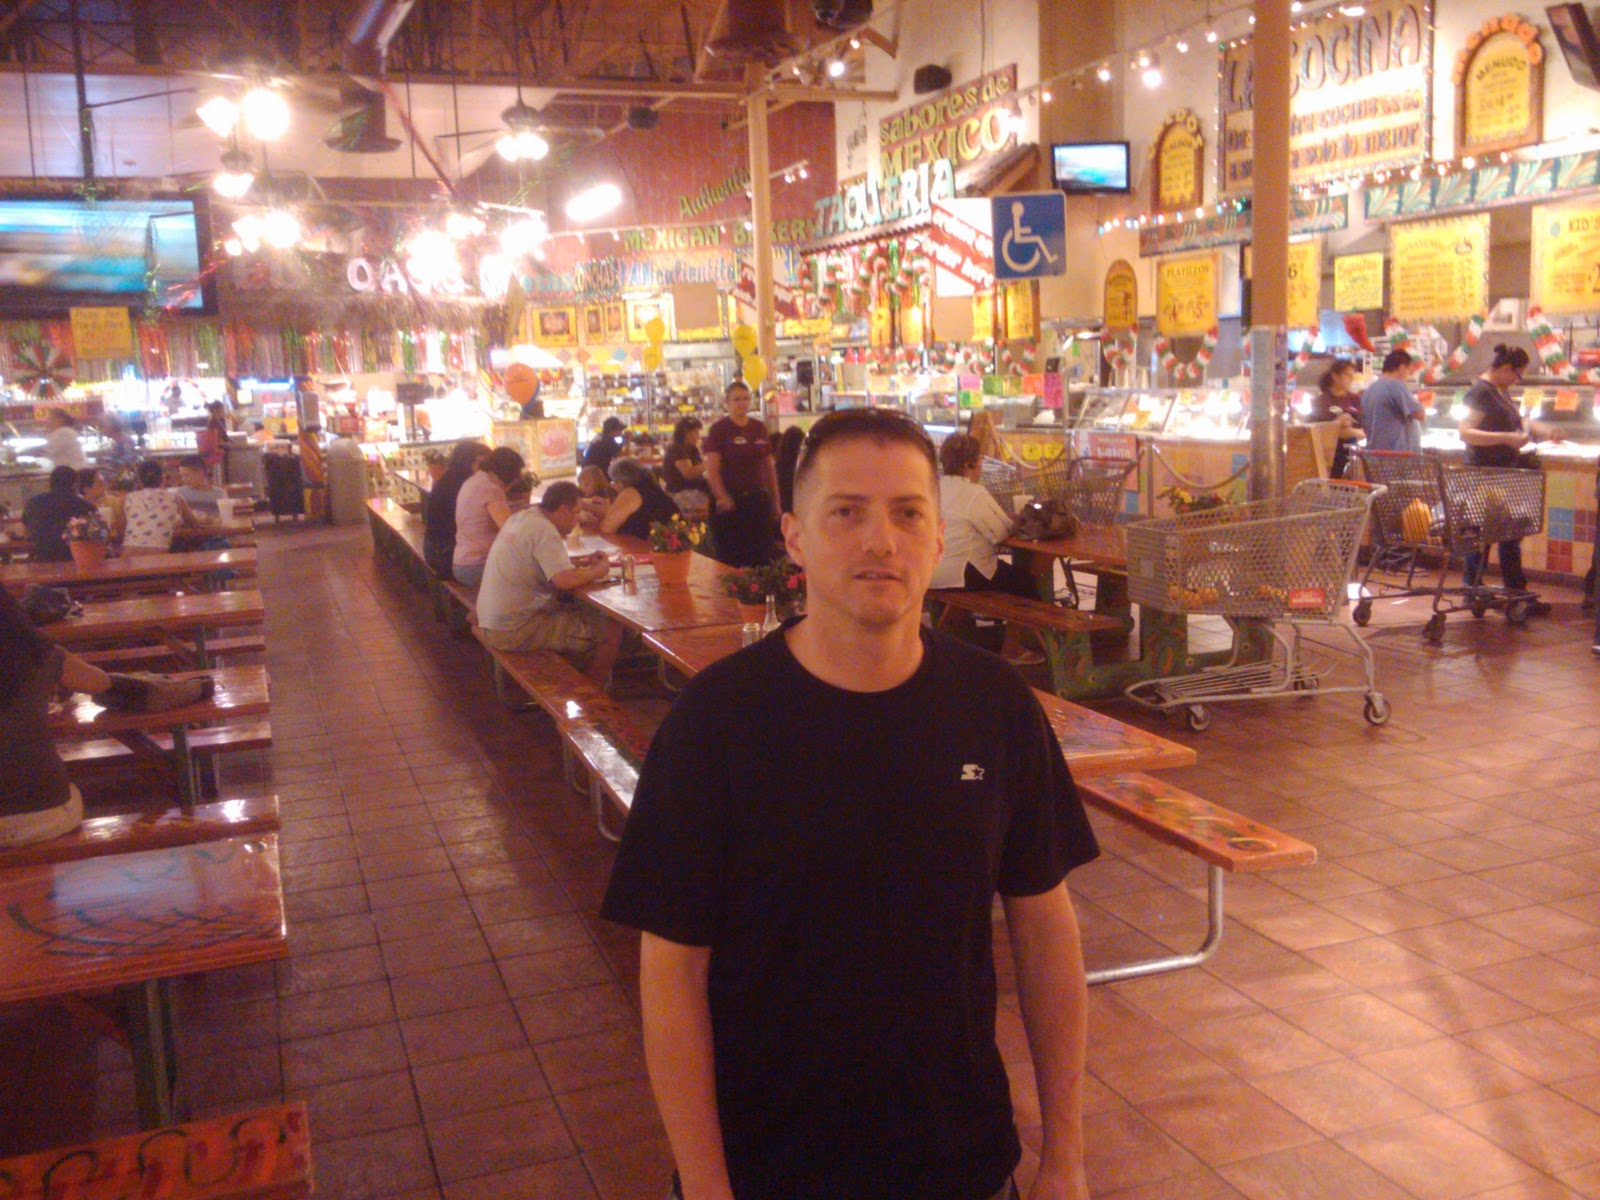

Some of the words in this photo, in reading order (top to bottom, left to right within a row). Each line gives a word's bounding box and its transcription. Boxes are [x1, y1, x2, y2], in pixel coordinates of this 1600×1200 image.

[880, 107, 1013, 188] MEXICO
[623, 225, 721, 252] MEXICAN
[733, 216, 820, 247] BKERY
[812, 157, 956, 239] TAQUERIA
